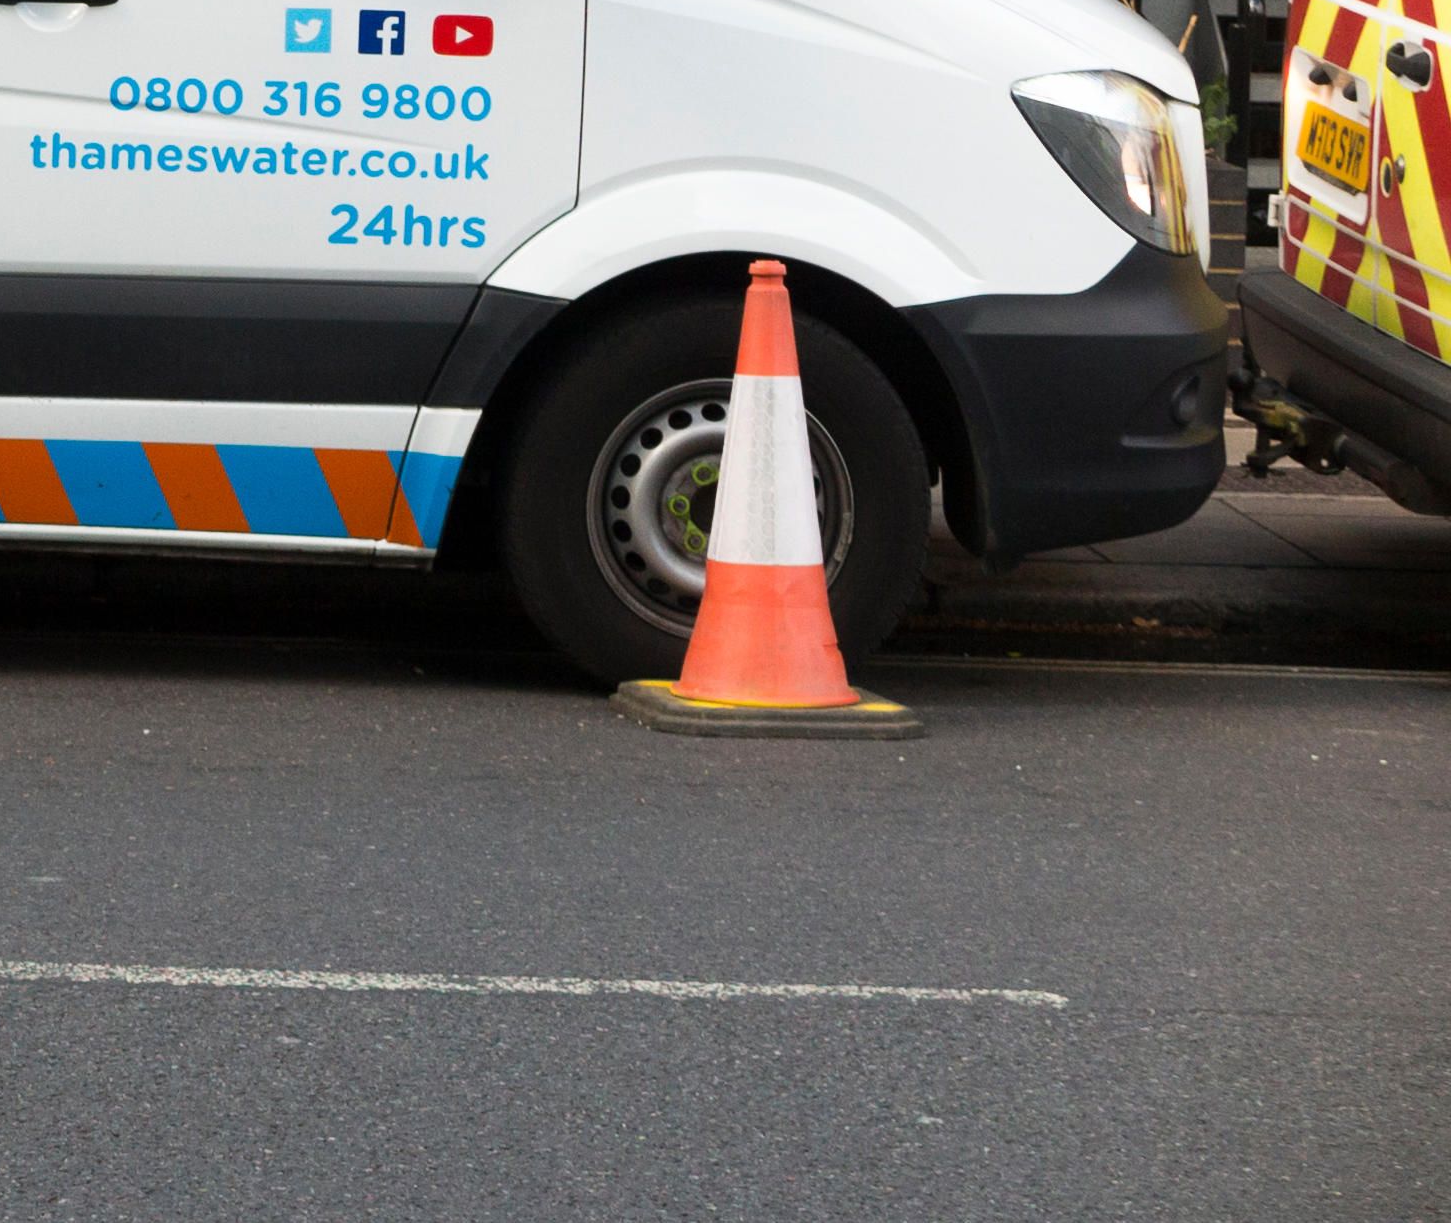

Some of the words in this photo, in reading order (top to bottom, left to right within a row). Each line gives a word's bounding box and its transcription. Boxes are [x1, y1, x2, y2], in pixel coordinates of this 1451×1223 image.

[110, 76, 243, 115] 0800
[263, 81, 341, 117] 316
[362, 84, 491, 121] 9800
[30, 132, 488, 180] thameswater.co.uk
[328, 204, 485, 248] 24hrs
